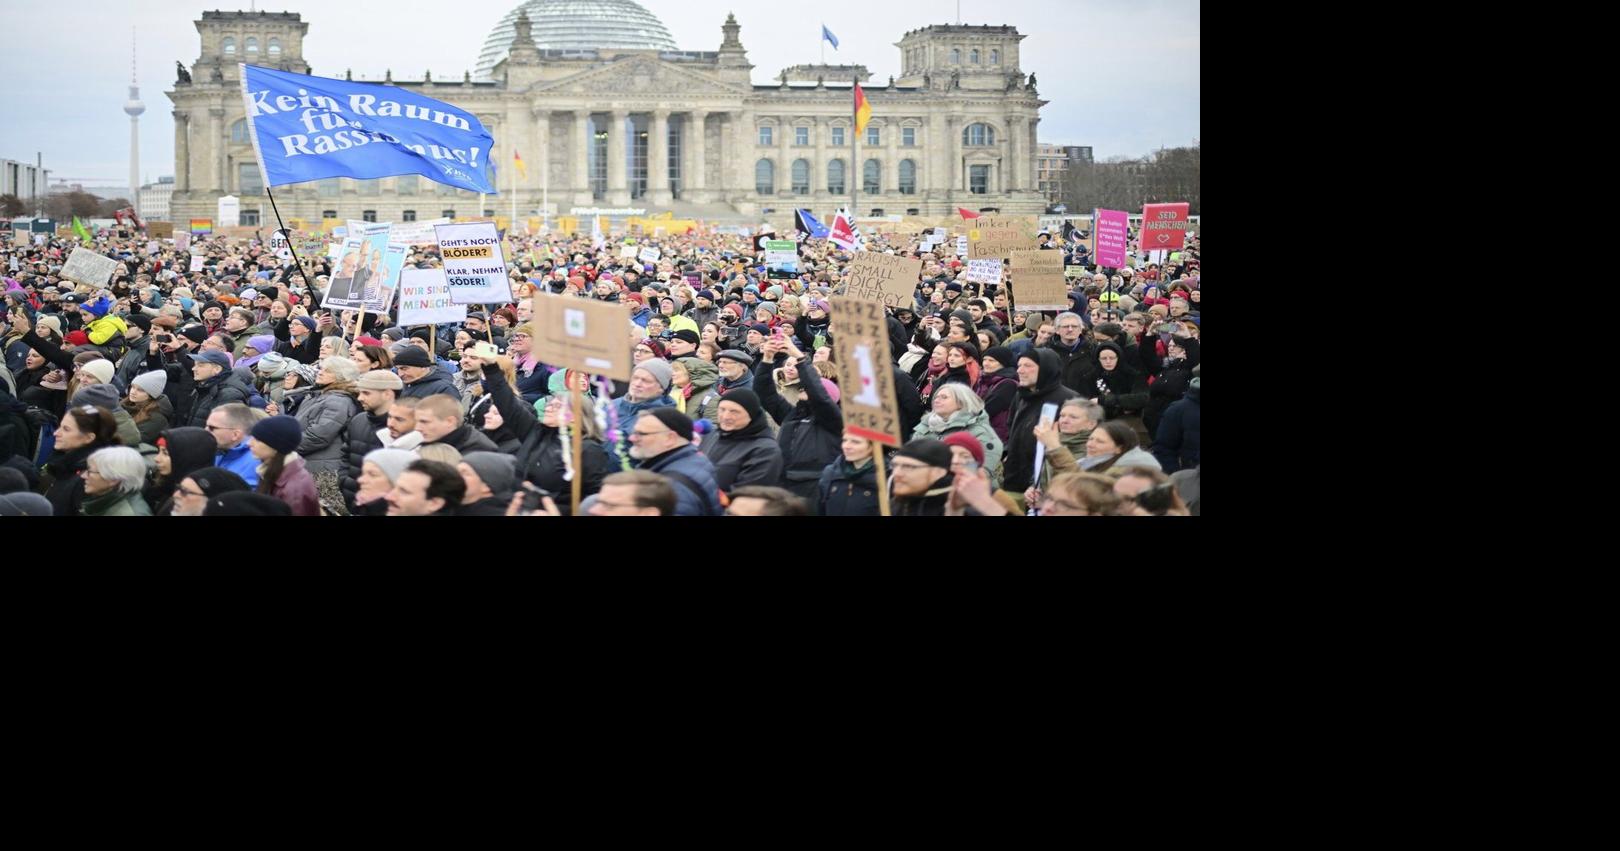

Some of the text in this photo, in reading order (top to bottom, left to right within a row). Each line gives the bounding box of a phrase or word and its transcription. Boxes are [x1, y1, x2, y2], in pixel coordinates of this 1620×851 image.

[248, 88, 472, 132] Kein Raum
[440, 238, 498, 247] GEHT'S NOCH
[443, 247, 487, 258] BLÖDER?
[857, 251, 900, 268] RACISM
[446, 267, 504, 276] KLAR, NEHMT
[854, 264, 894, 280] SMALL
[449, 276, 486, 286] SÖDER!
[850, 272, 885, 290] DICK
[403, 285, 449, 296] WIR SIND
